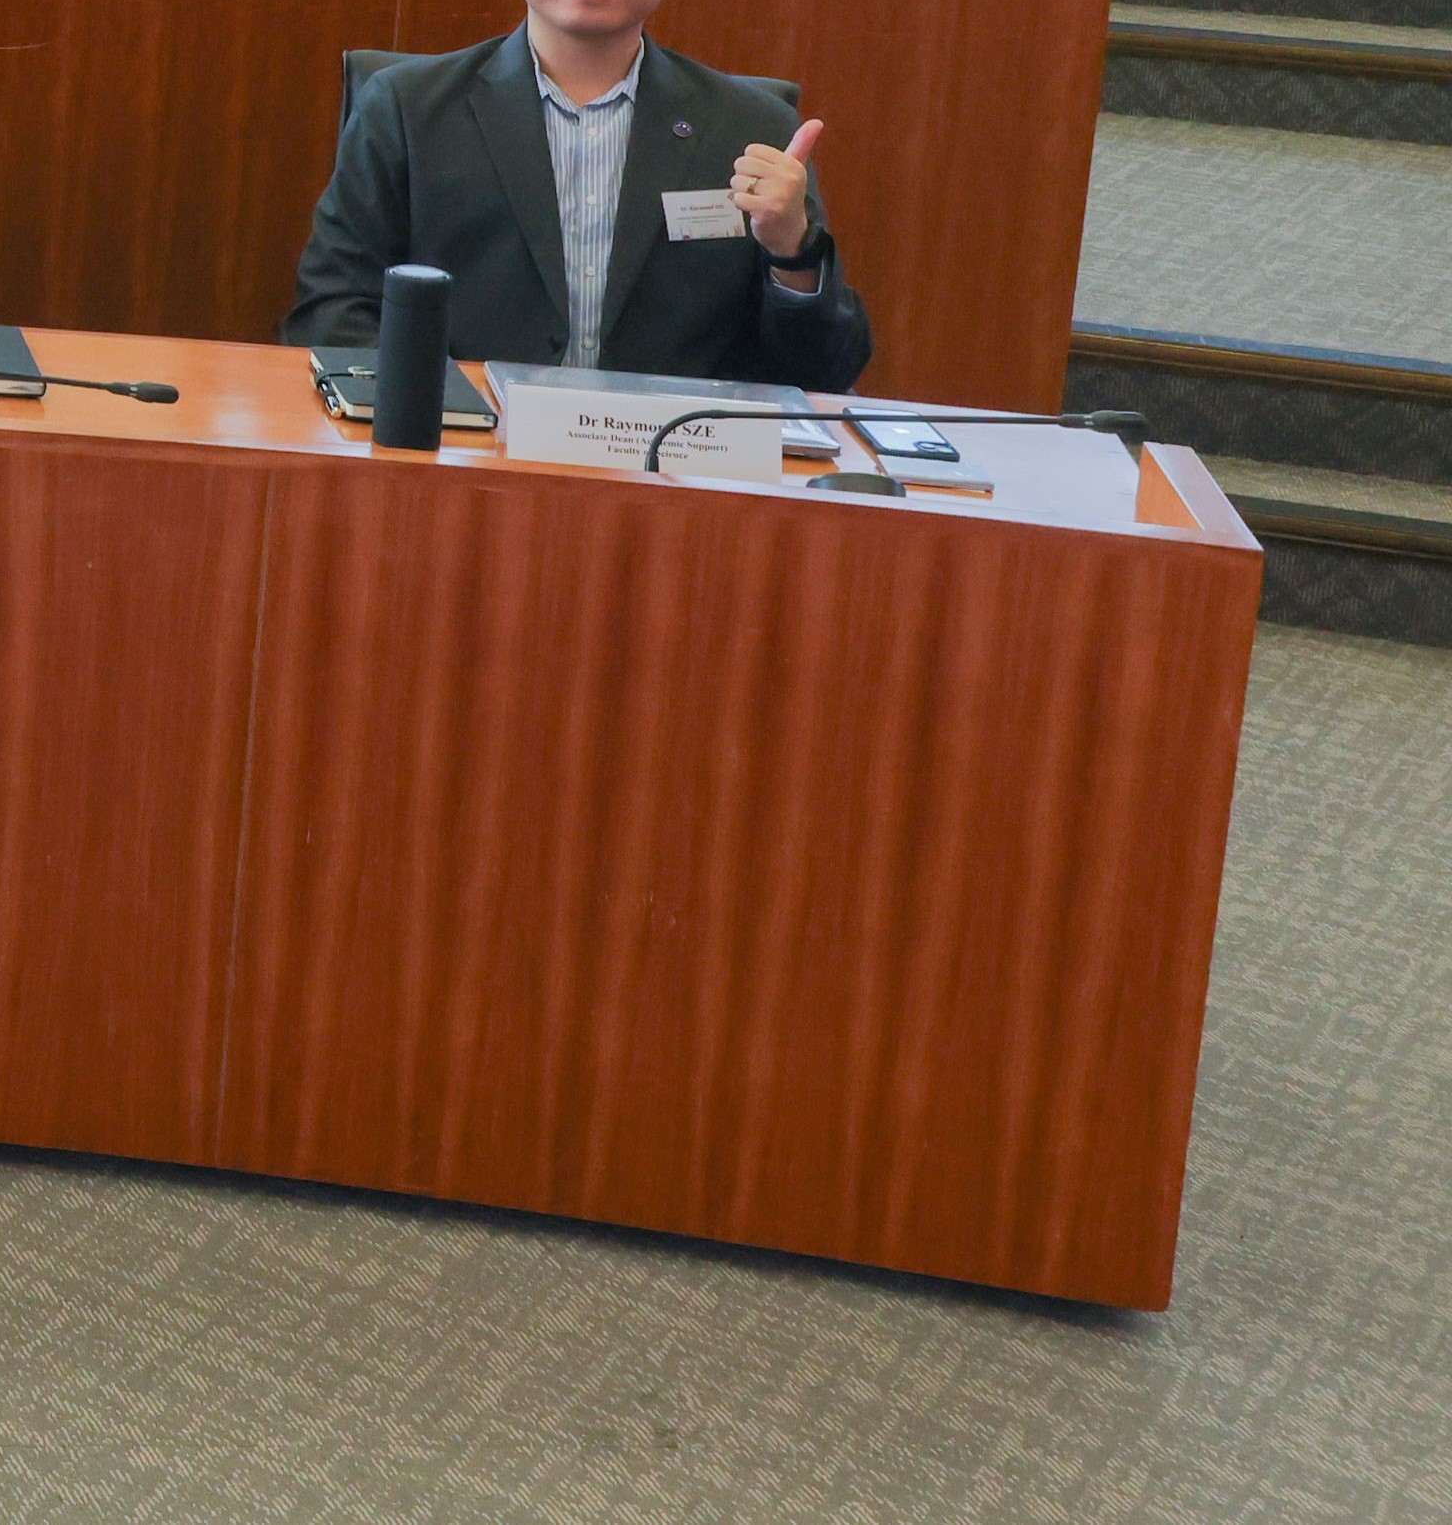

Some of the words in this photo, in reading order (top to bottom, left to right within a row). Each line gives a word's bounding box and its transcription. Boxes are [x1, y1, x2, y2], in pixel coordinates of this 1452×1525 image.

[579, 415, 599, 427] Dr
[682, 424, 716, 438] SZE
[567, 431, 608, 441] Associate
[611, 435, 634, 443] Dean
[687, 442, 729, 453] Support)
[608, 445, 640, 455] Faculty
